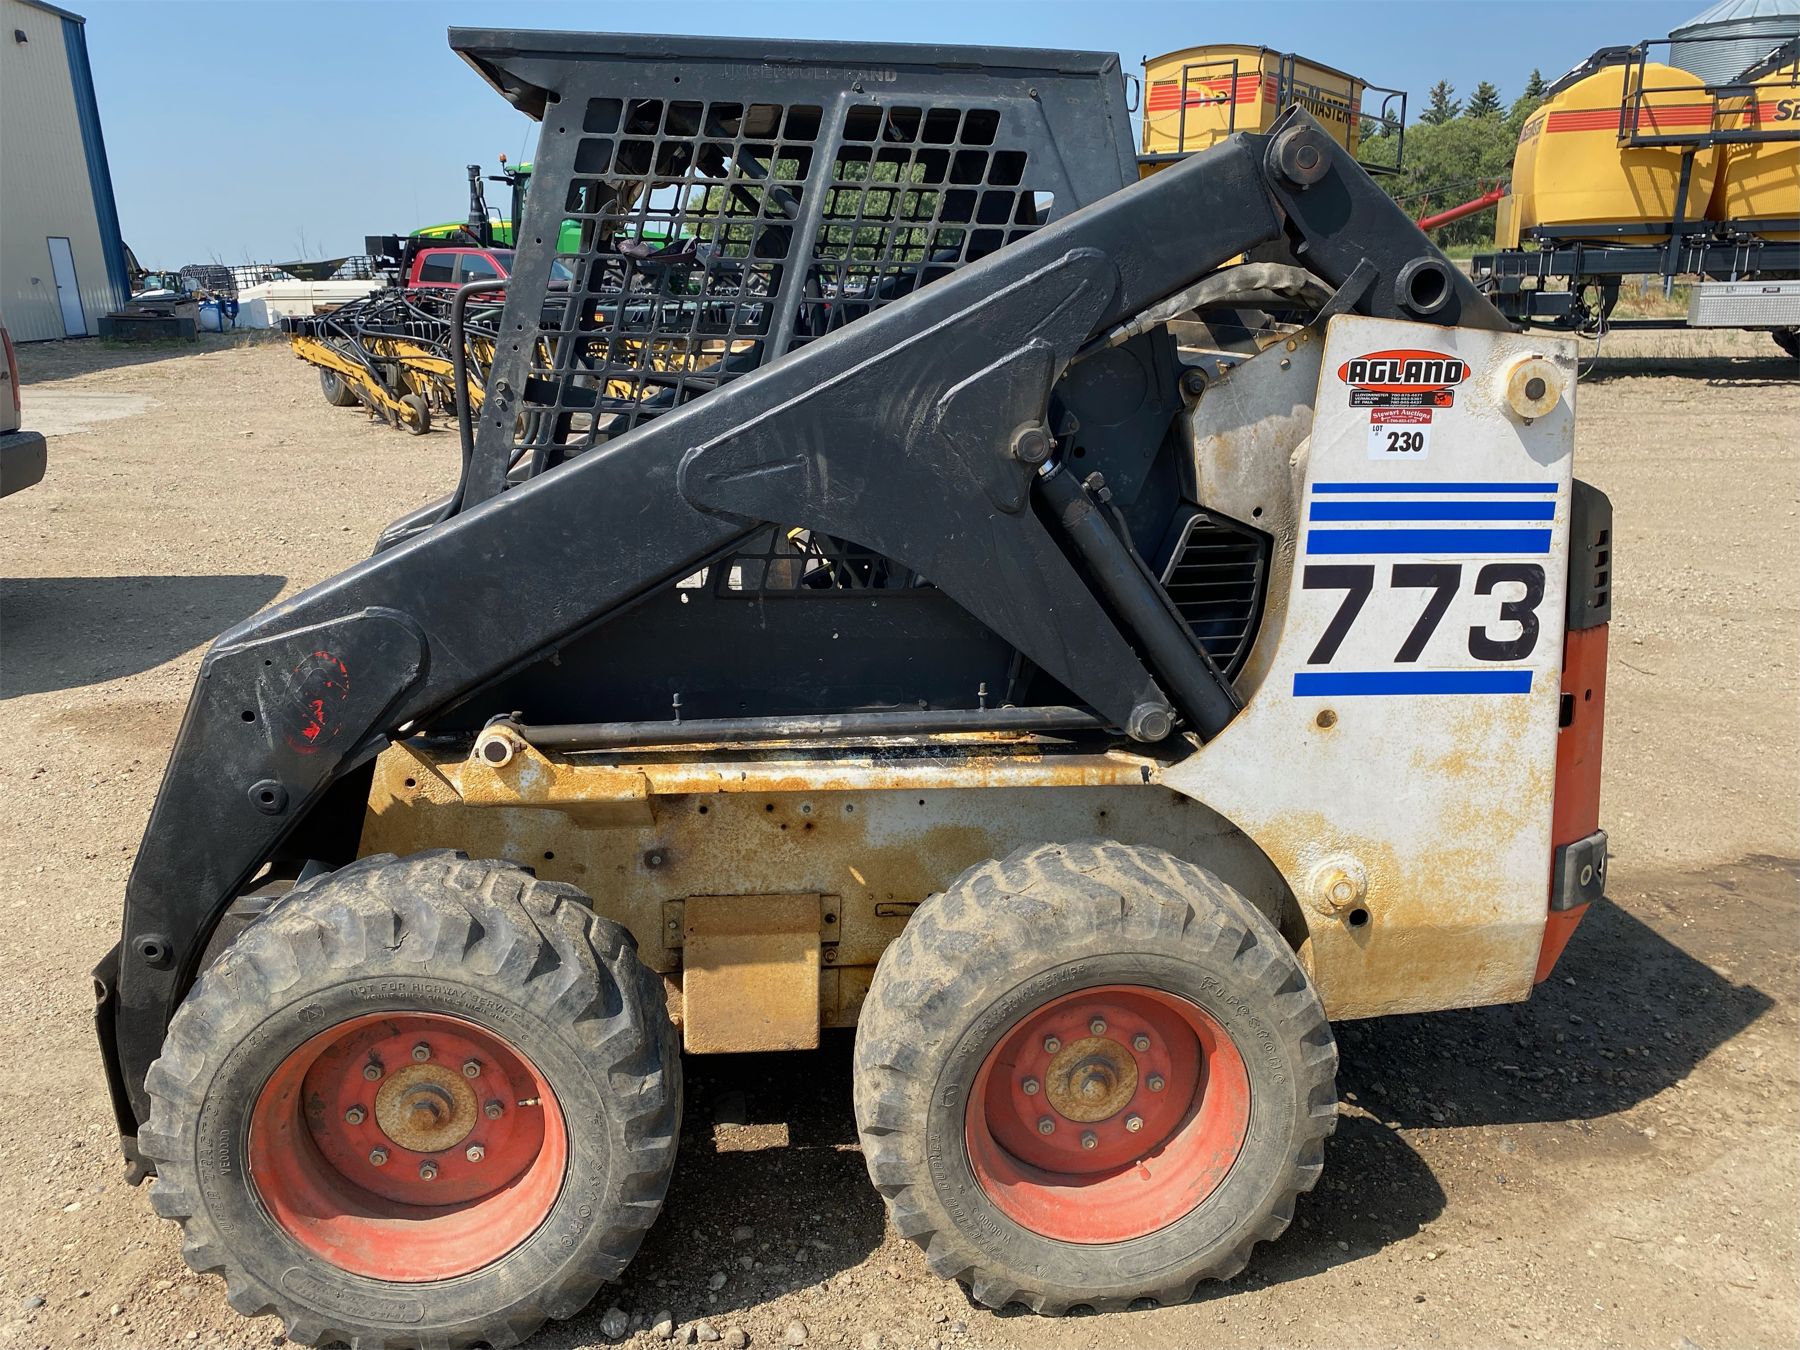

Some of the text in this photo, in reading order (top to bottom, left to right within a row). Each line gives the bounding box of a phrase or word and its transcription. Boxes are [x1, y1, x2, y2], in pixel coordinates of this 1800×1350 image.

[1347, 360, 1464, 383] AGLAND
[1372, 409, 1431, 419] Stewart Auctions
[1386, 431, 1424, 452] 230
[1302, 562, 1546, 665] 773
[350, 983, 375, 998] NOT
[379, 982, 406, 992] FOR
[412, 983, 468, 1000] HIGHWAY
